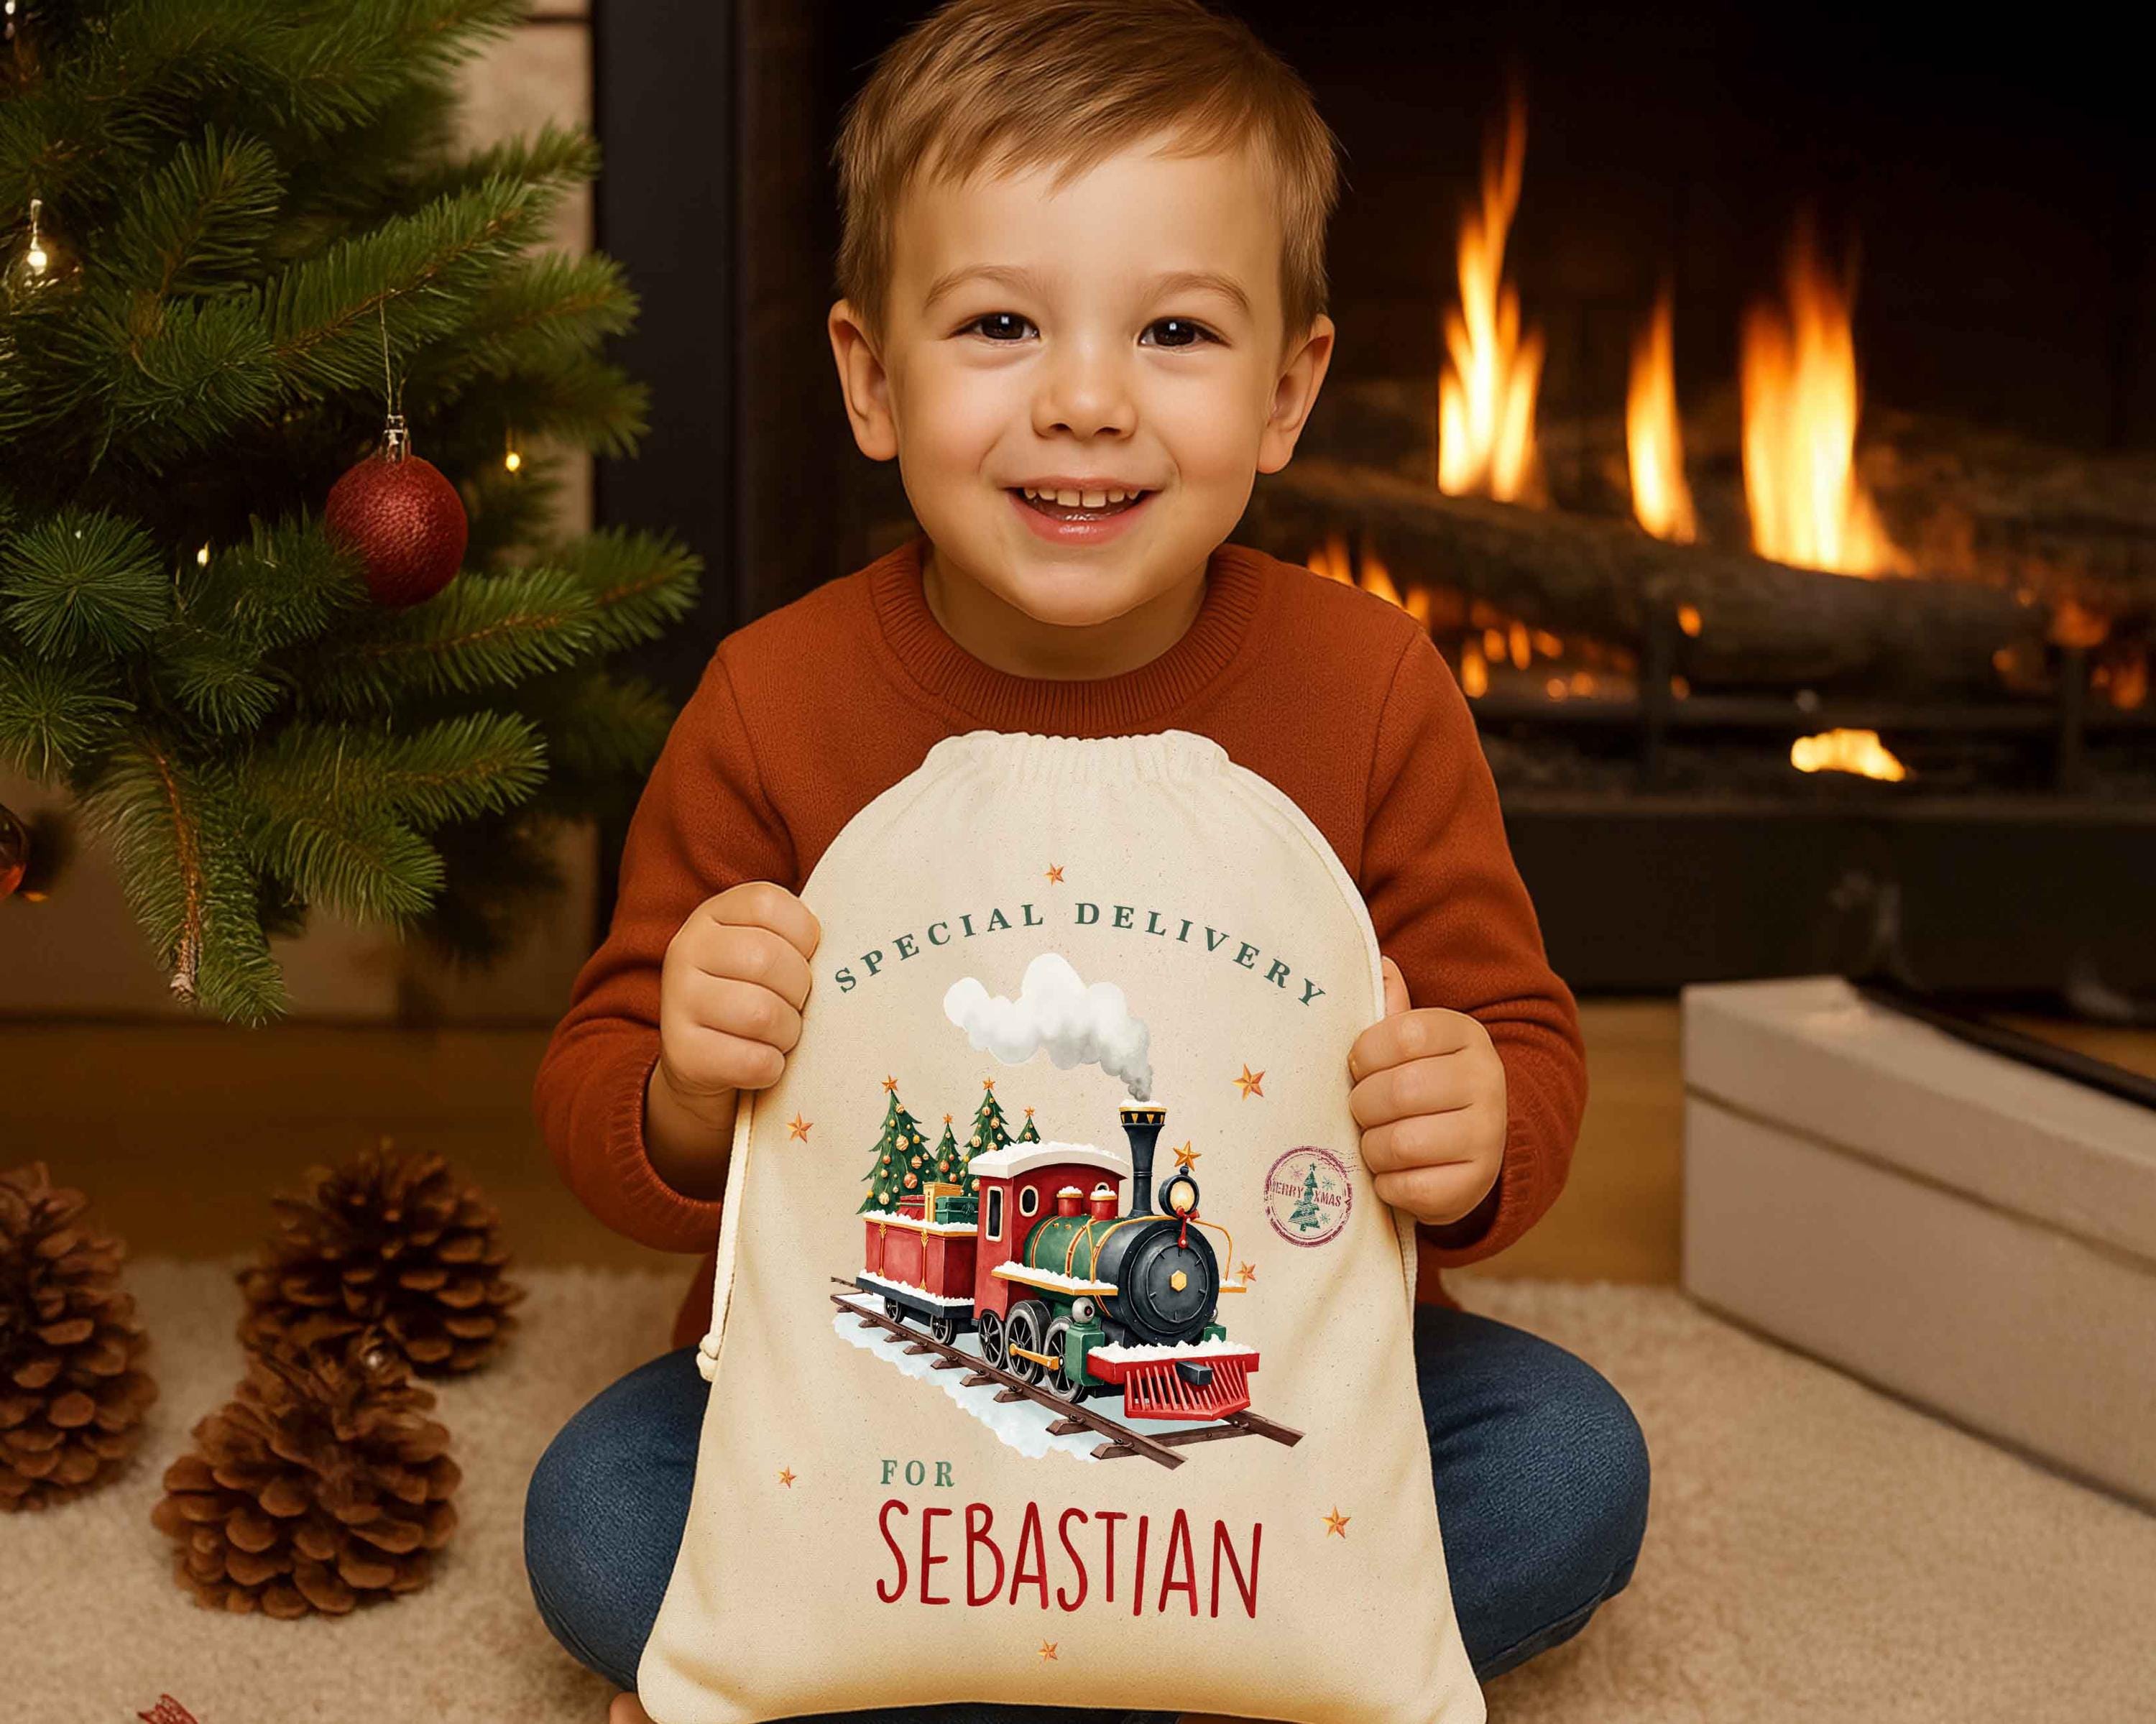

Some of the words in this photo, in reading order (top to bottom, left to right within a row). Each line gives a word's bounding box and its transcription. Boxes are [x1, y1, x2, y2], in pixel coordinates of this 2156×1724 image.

[834, 903, 1044, 994] SPECIAL
[1074, 902, 1327, 1007] DELIVERY
[1269, 1181, 1304, 1199] MERRY
[1314, 1189, 1342, 1207] XMAS
[880, 1460, 955, 1487] FOR
[876, 1499, 1263, 1619] SEBASTIAN
